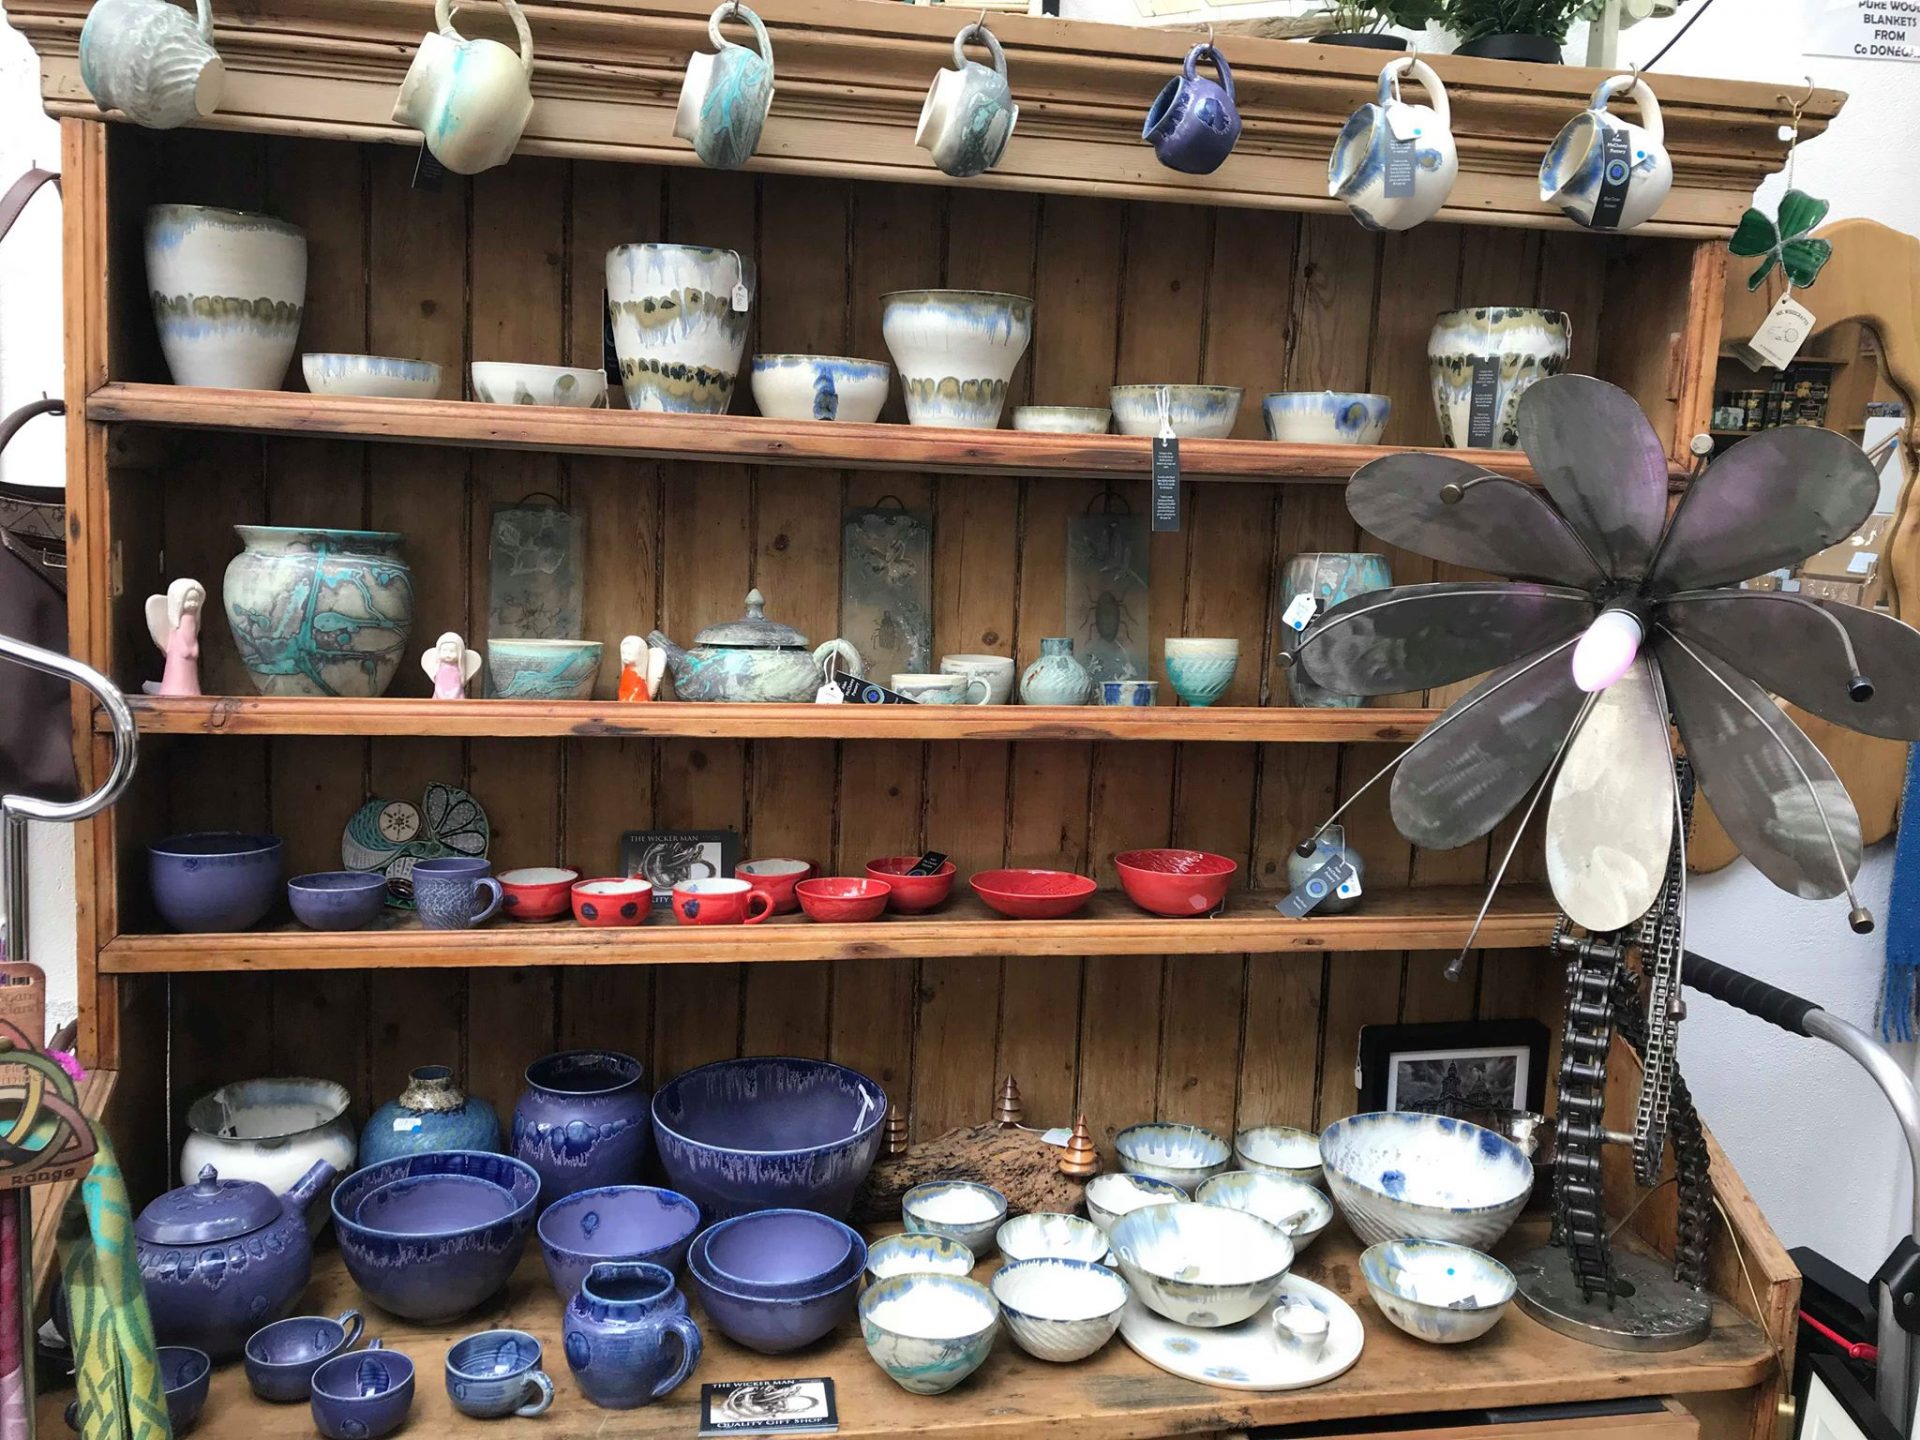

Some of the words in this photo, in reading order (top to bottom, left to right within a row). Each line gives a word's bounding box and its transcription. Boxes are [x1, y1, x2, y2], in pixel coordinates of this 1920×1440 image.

[1858, 0, 1887, 10] PURE
[1863, 13, 1917, 27] BLANKETS
[1874, 29, 1906, 41] FROM
[1854, 43, 1868, 54] Co
[717, 1420, 763, 1429] QUALITY
[765, 1418, 792, 1426] GIFT
